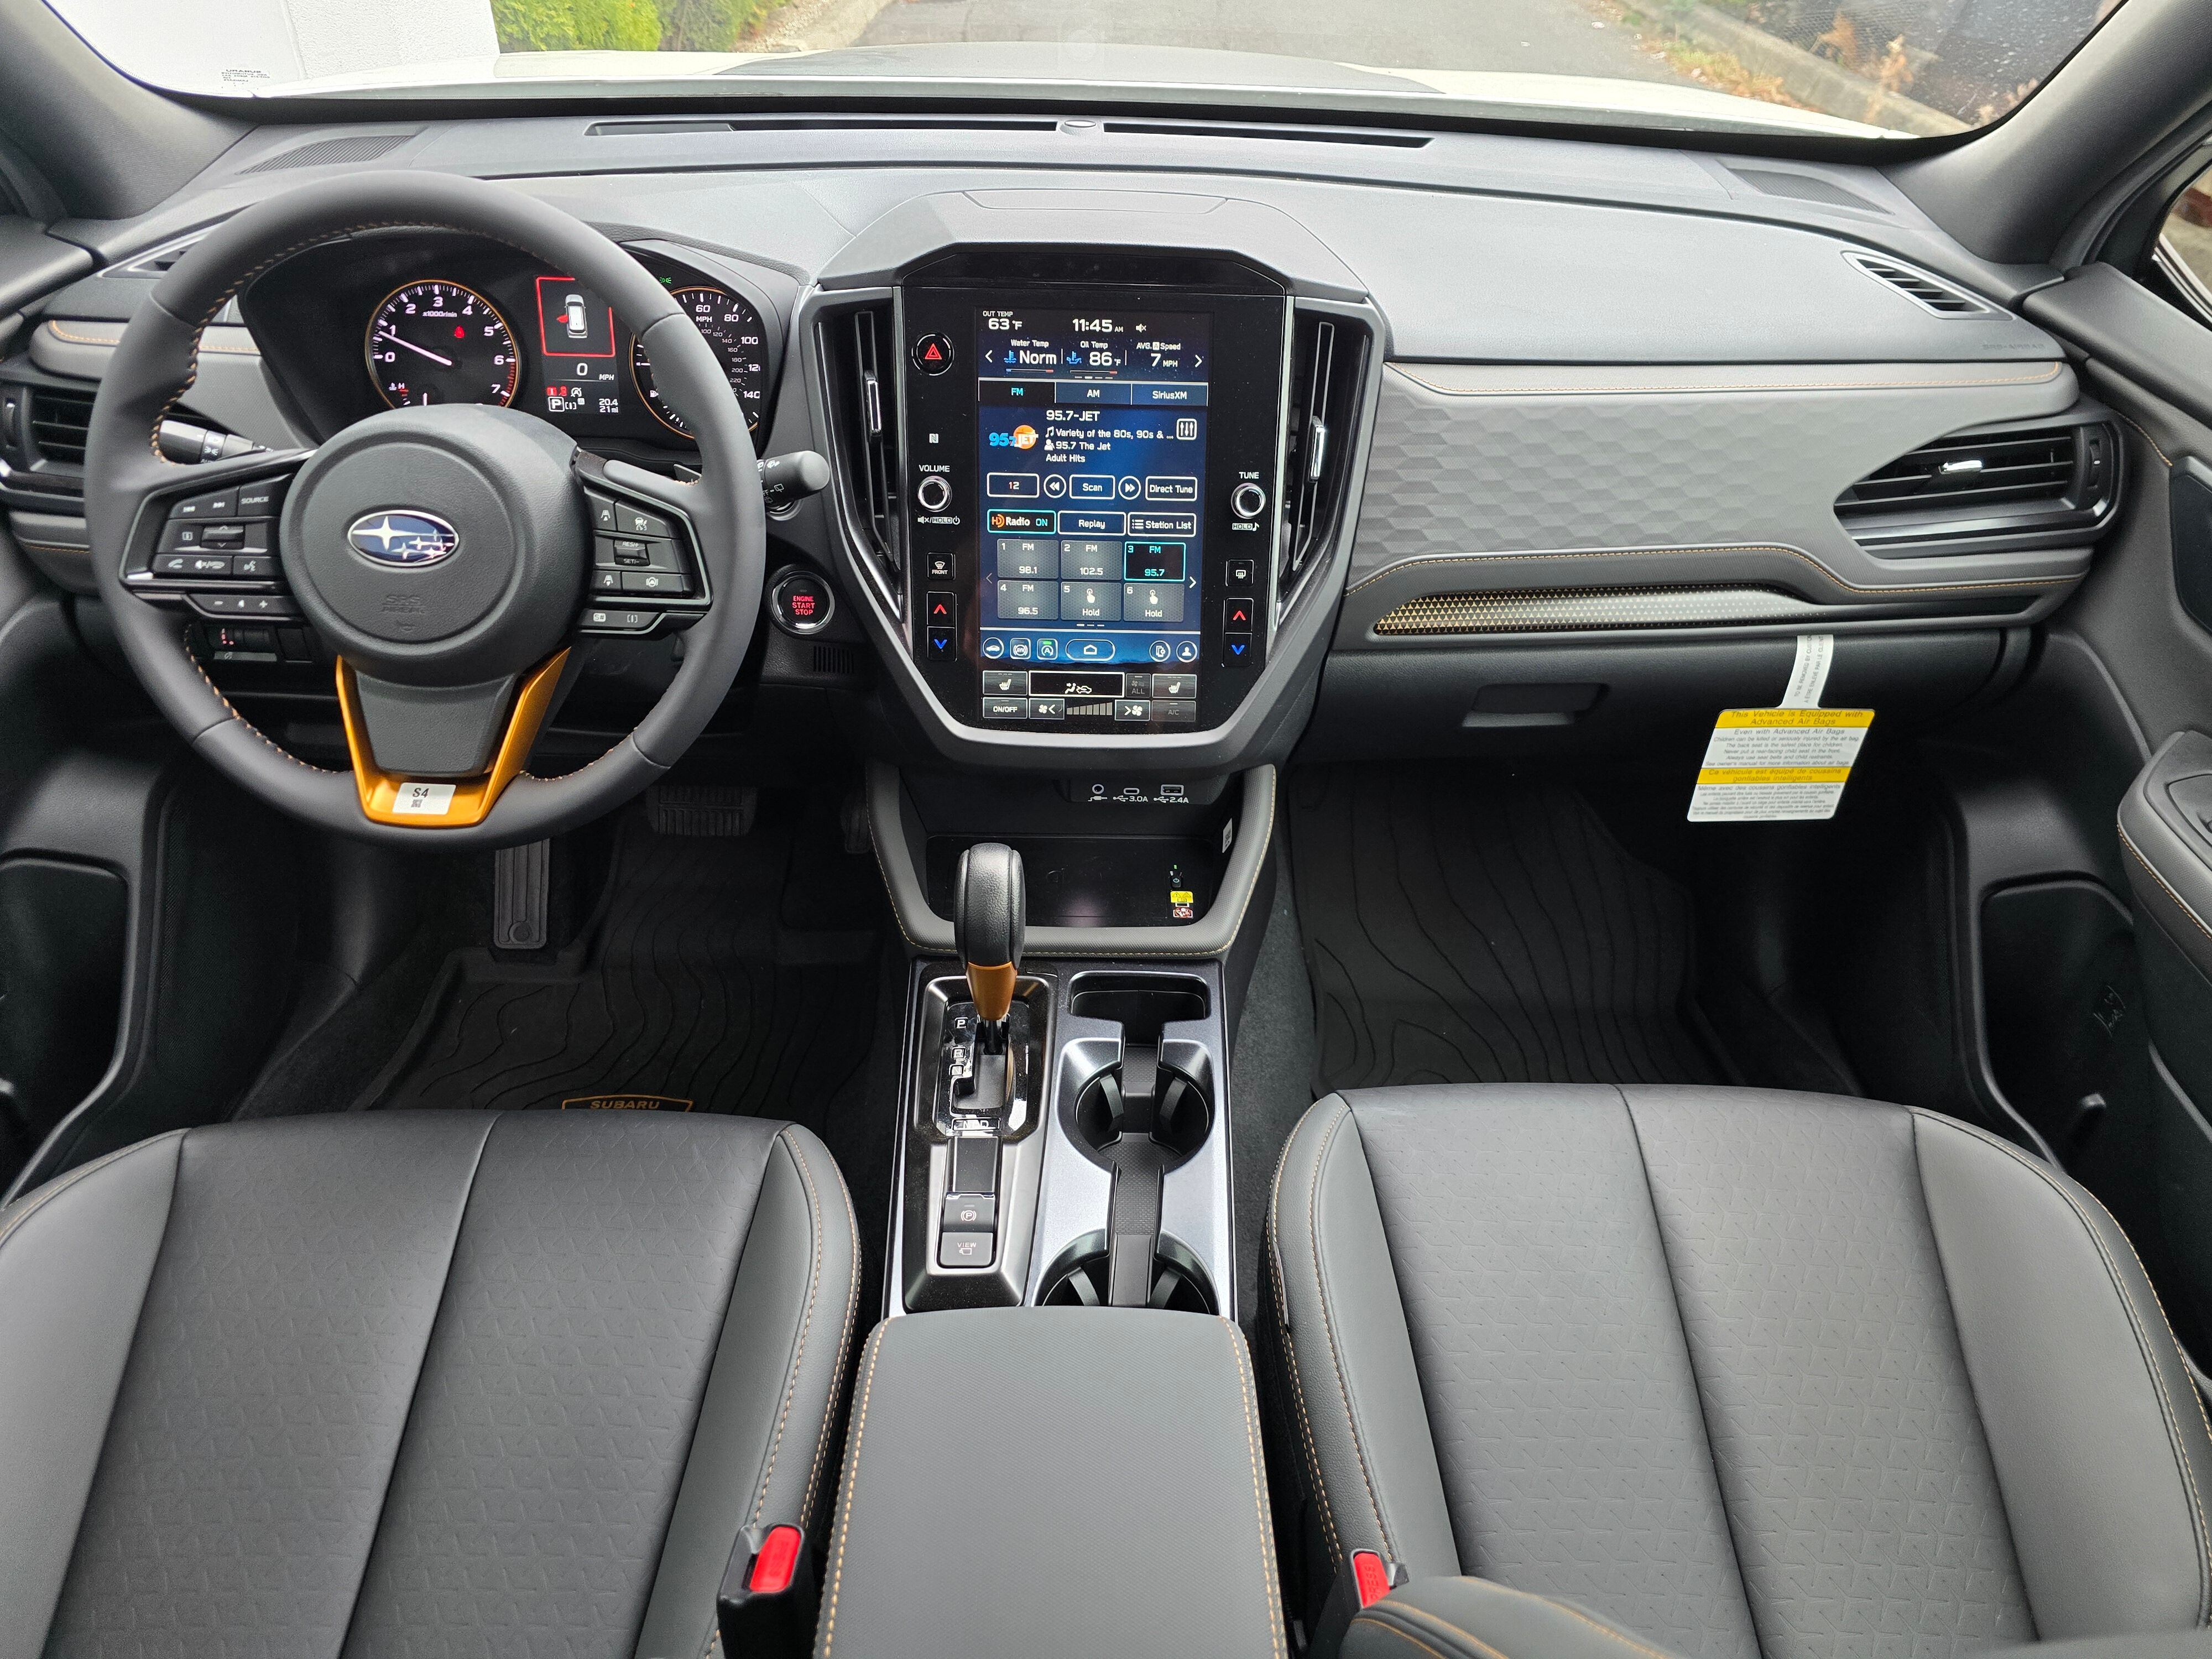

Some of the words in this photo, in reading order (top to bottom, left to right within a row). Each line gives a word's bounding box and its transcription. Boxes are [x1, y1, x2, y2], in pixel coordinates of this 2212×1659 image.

[433, 296, 443, 307] 3
[405, 304, 416, 314] 2
[462, 305, 473, 315] 4
[696, 305, 711, 313] 60
[988, 318, 1010, 330] 63
[1072, 319, 1113, 332] 11:45
[389, 325, 396, 336] 1
[483, 326, 494, 336] 5
[741, 336, 759, 345] 100
[1032, 340, 1049, 348] Temp
[1091, 341, 1108, 349] Temp
[1160, 343, 1181, 351] Speed
[385, 352, 395, 362] 0
[494, 355, 504, 365] 6
[1019, 350, 1056, 364] Norm
[1089, 352, 1112, 366] 86
[1150, 353, 1161, 367] 7
[577, 363, 588, 376] 0
[491, 384, 501, 394] 7
[1011, 388, 1023, 396] FM
[1087, 389, 1100, 398] AM
[1152, 390, 1187, 400] SiriusXM
[552, 399, 561, 409] P
[1046, 410, 1100, 421] 95.7-JET
[1056, 429, 1084, 439] Variety
[1114, 430, 1134, 440] 80s,
[1136, 430, 1154, 439] 90s
[1056, 441, 1076, 450] 95.7
[1097, 442, 1111, 450] Jet
[1046, 453, 1067, 462] Adult
[1008, 482, 1020, 490] 12
[1082, 483, 1103, 492] Scan
[1149, 484, 1173, 493] Direct
[1175, 485, 1193, 493] Tune
[1005, 517, 1030, 526] Radio
[1078, 520, 1105, 529] Replay
[1145, 520, 1173, 530] Station
[1176, 521, 1191, 529] List
[1086, 544, 1098, 552] FM
[1080, 567, 1103, 576] 102.5
[1082, 608, 1100, 617] Hold
[1145, 609, 1162, 618] Hold
[1799, 710, 1843, 718] Equipped
[413, 787, 429, 798] S4
[957, 1019, 967, 1029] P
[954, 1049, 963, 1058] R
[590, 1100, 660, 1109] SUBARU
